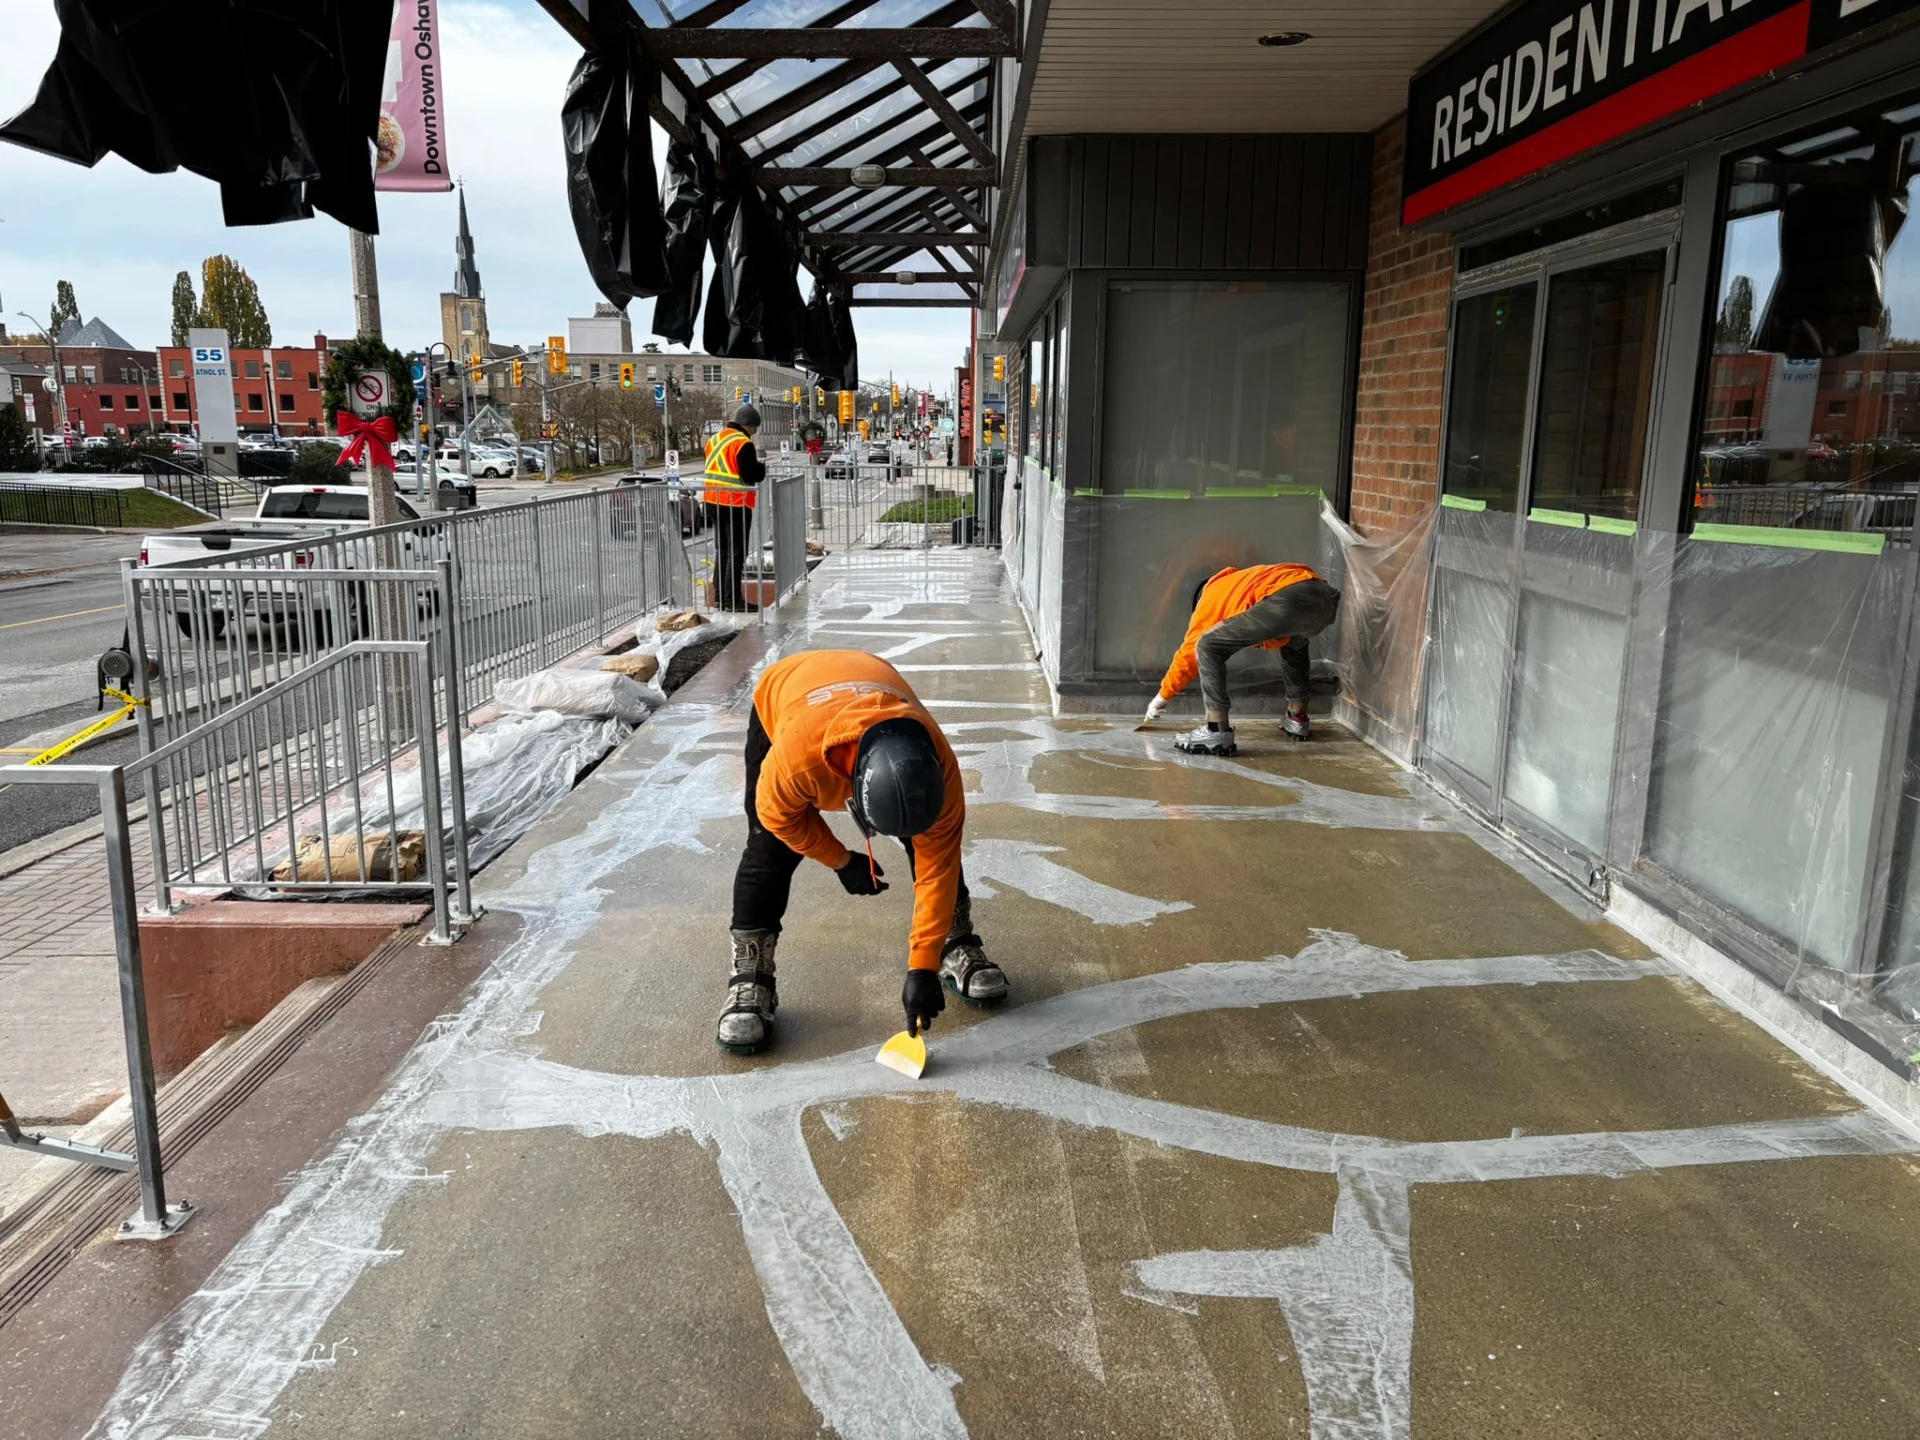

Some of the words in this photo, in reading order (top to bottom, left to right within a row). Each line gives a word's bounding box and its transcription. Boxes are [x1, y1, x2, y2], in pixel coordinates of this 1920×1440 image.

[420, 64, 442, 175] Downtown
[1431, 0, 1752, 169] RESIDENTI
[196, 349, 222, 361] 55
